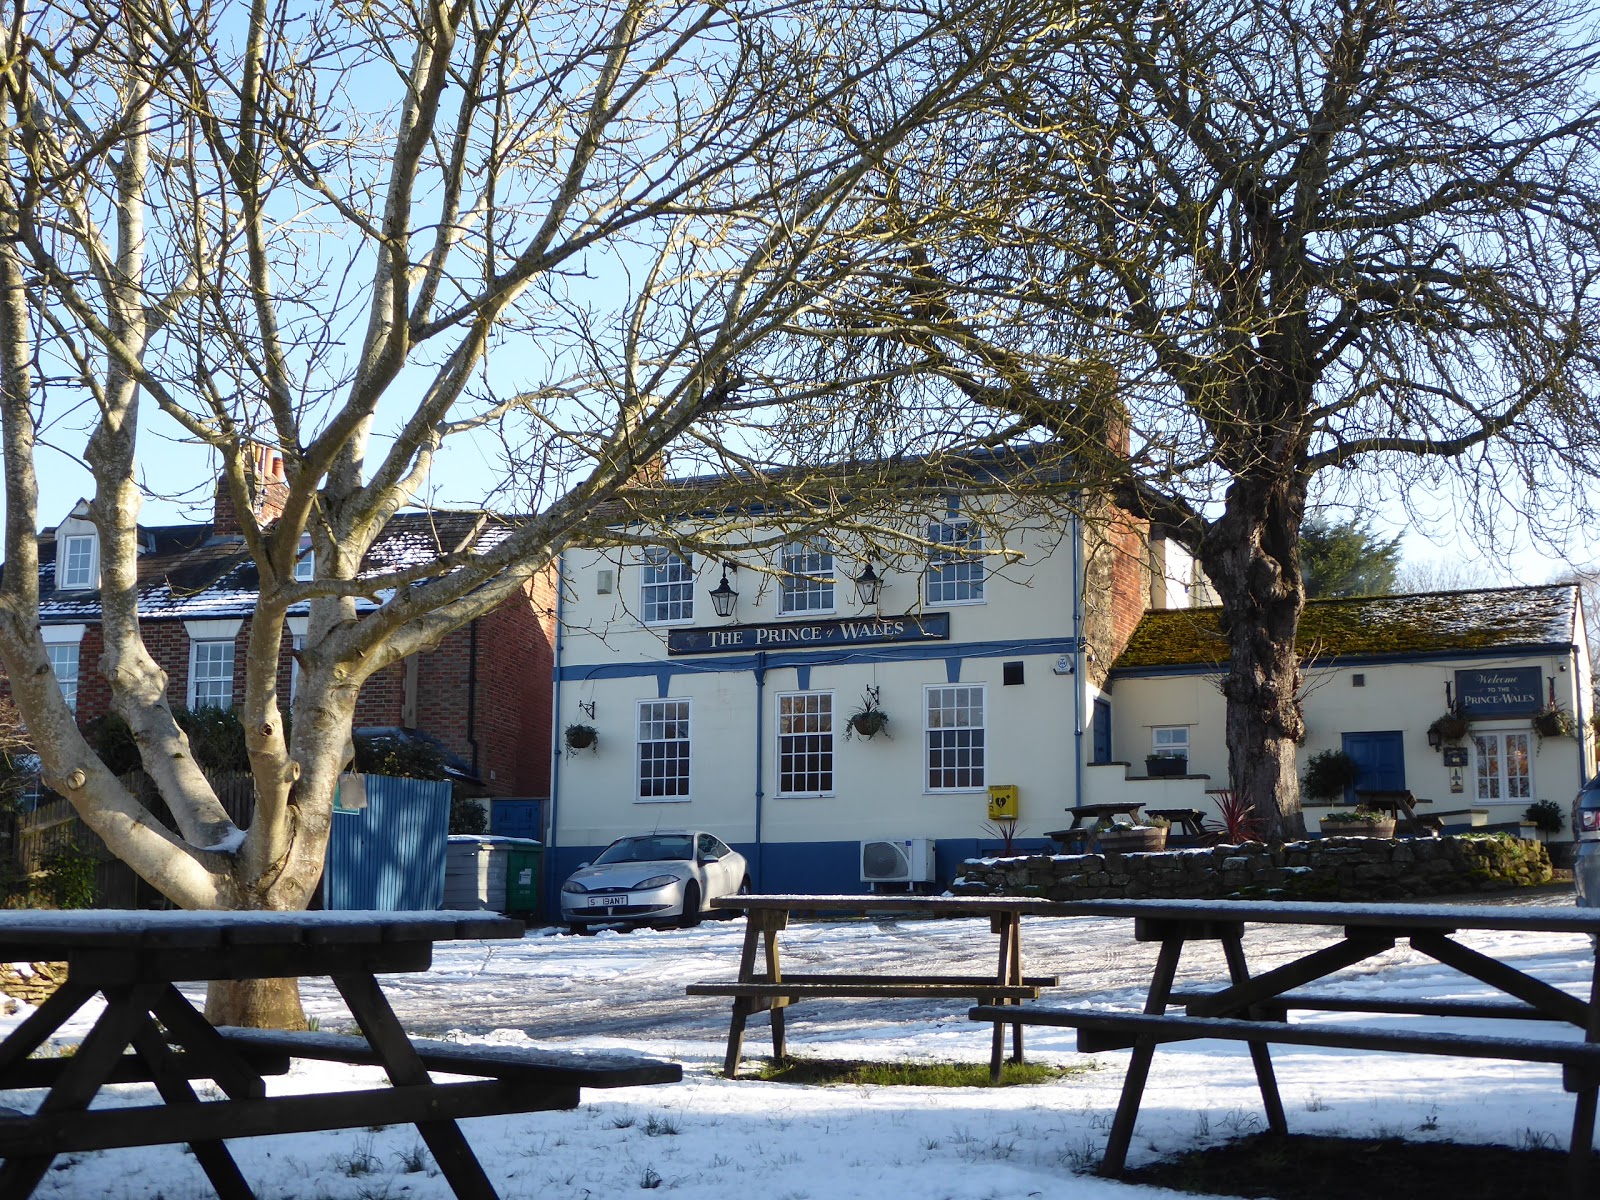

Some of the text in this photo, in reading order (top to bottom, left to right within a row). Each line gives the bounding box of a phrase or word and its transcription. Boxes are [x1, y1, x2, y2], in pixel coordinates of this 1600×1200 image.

[708, 631, 743, 648] THE
[755, 626, 822, 645] PRINCE
[839, 621, 904, 640] WALES
[1477, 674, 1519, 684] Welcome
[1464, 695, 1498, 706] PRINCE
[1502, 693, 1535, 704] WALES
